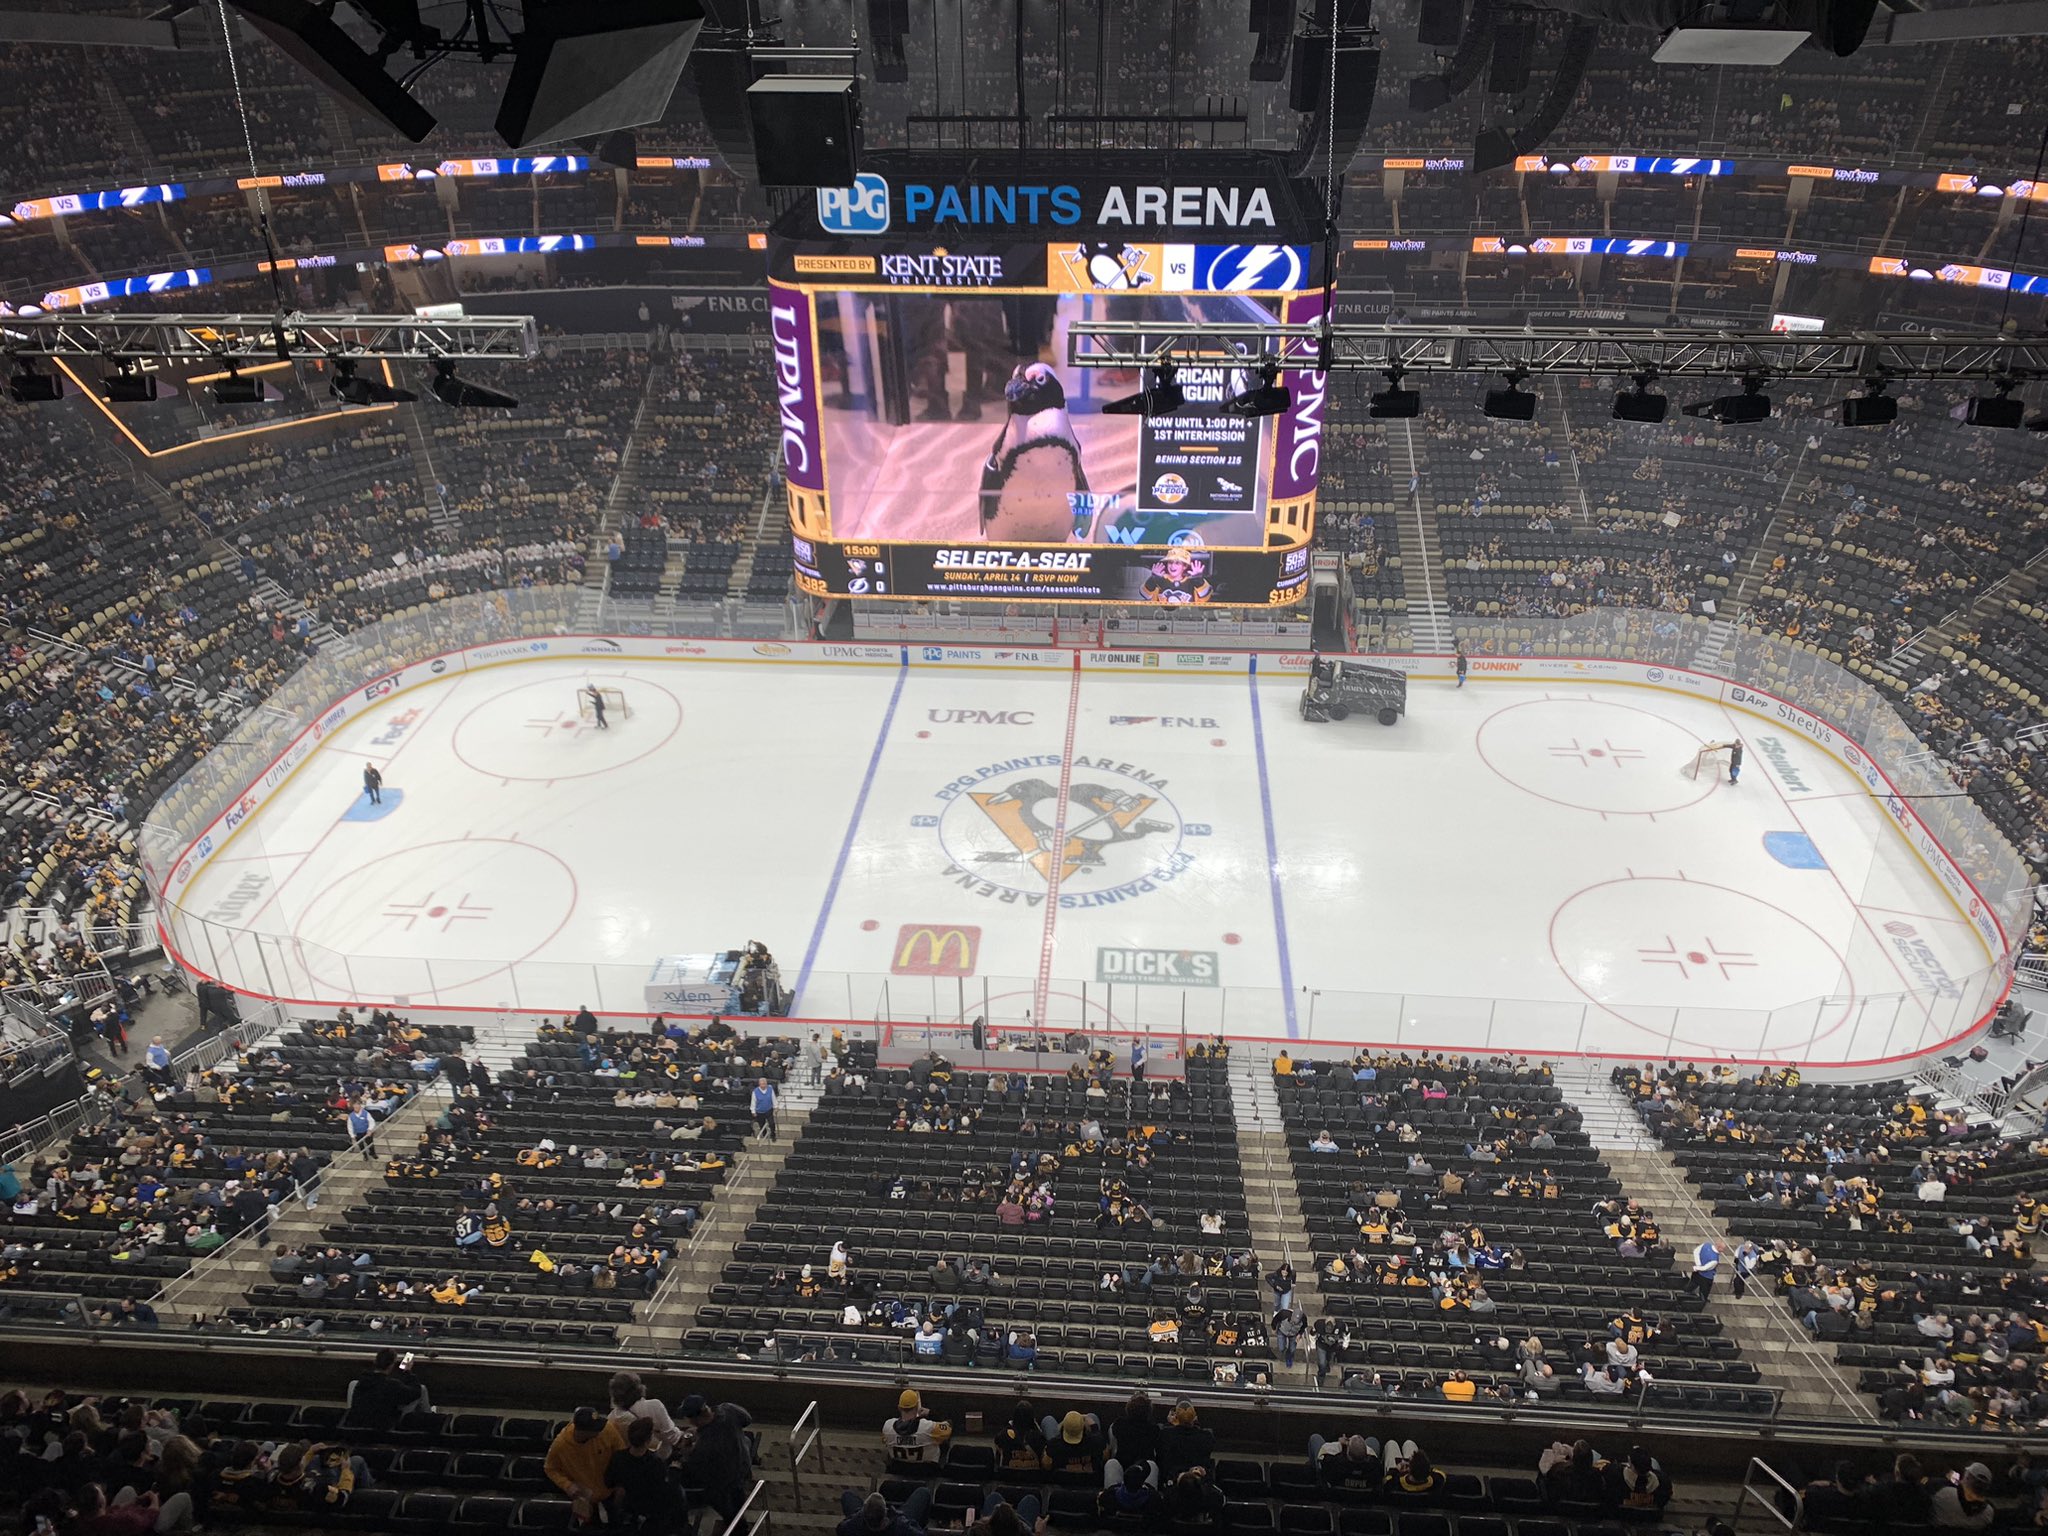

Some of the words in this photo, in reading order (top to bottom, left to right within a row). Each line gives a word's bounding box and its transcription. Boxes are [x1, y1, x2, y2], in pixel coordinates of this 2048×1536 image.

[479, 162, 492, 171] VS
[1444, 160, 1464, 168] STATE
[1615, 159, 1628, 169] VS
[1835, 169, 1856, 179] KENT
[1856, 171, 1879, 181] STATE
[57, 199, 73, 209] VS
[822, 181, 885, 227] PPG
[905, 185, 1082, 225] PAINTS
[1097, 186, 1277, 227] ARENA
[485, 242, 498, 251] VS
[1407, 241, 1426, 249] STATE
[1572, 241, 1586, 250] VS
[1777, 251, 1797, 261] KENT
[1797, 253, 1817, 262] STATE
[797, 259, 857, 269] PRESENTED
[858, 260, 872, 270] BY
[880, 255, 941, 276] KENT
[941, 255, 1003, 277] STATE
[1170, 263, 1186, 274] VS
[890, 276, 994, 286] UNIVERSITY
[1987, 272, 2003, 284] VS
[86, 287, 101, 298] VS
[1373, 304, 1390, 314] CLUB
[1568, 311, 1626, 321] PENGUINS
[771, 305, 809, 473] UPMC
[1148, 417, 1174, 429] NOW
[1174, 417, 1204, 428] UNTIL
[1206, 418, 1227, 429] 1:00
[1229, 418, 1245, 429] PM
[1154, 430, 1173, 440] 1ST
[1174, 430, 1245, 441] INTERMISSION
[1155, 455, 1188, 464] BEHIND
[1190, 456, 1226, 465] SECTION
[1153, 487, 1188, 495] PLEDGE
[844, 545, 878, 556] 15:00
[934, 549, 1092, 569] SELECT-A-SEAT
[874, 562, 885, 573] 0
[943, 572, 981, 582] SUNDAY,
[983, 573, 1009, 582] APRIL
[1010, 573, 1021, 582] 14
[1032, 574, 1056, 583] RSVP
[1057, 575, 1079, 583] NOW
[875, 581, 886, 592] 0
[926, 583, 1101, 594] www.pittsburghpenguins.com/seasontickets
[821, 646, 864, 657] UPMC
[946, 650, 982, 660] PAINTS
[1090, 653, 1107, 663] PLAY
[1107, 654, 1141, 664] ONLINE
[1472, 661, 1523, 671] DUNKIN'
[365, 672, 402, 701] EQT
[321, 706, 346, 731] LUMBER
[928, 708, 1035, 725] UPMC
[371, 707, 424, 745] FedEx
[1161, 716, 1220, 729] F.N.B.
[1777, 703, 1831, 743] Sheely's
[265, 752, 294, 788] UPMC
[1762, 746, 1813, 792] Seubert
[934, 774, 977, 802] PPG
[974, 754, 1062, 778] PAINTS
[1074, 756, 1169, 791] ARENA
[225, 796, 257, 830] FedEx
[1920, 836, 1949, 874] UPMC
[942, 863, 1045, 908] ARENA
[1058, 880, 1157, 909] PAINTS
[1979, 912, 1998, 944] LUMBER
[1910, 939, 1962, 1000] VECTOR
[663, 989, 712, 1003] xylem
[456, 1218, 472, 1238] 87
